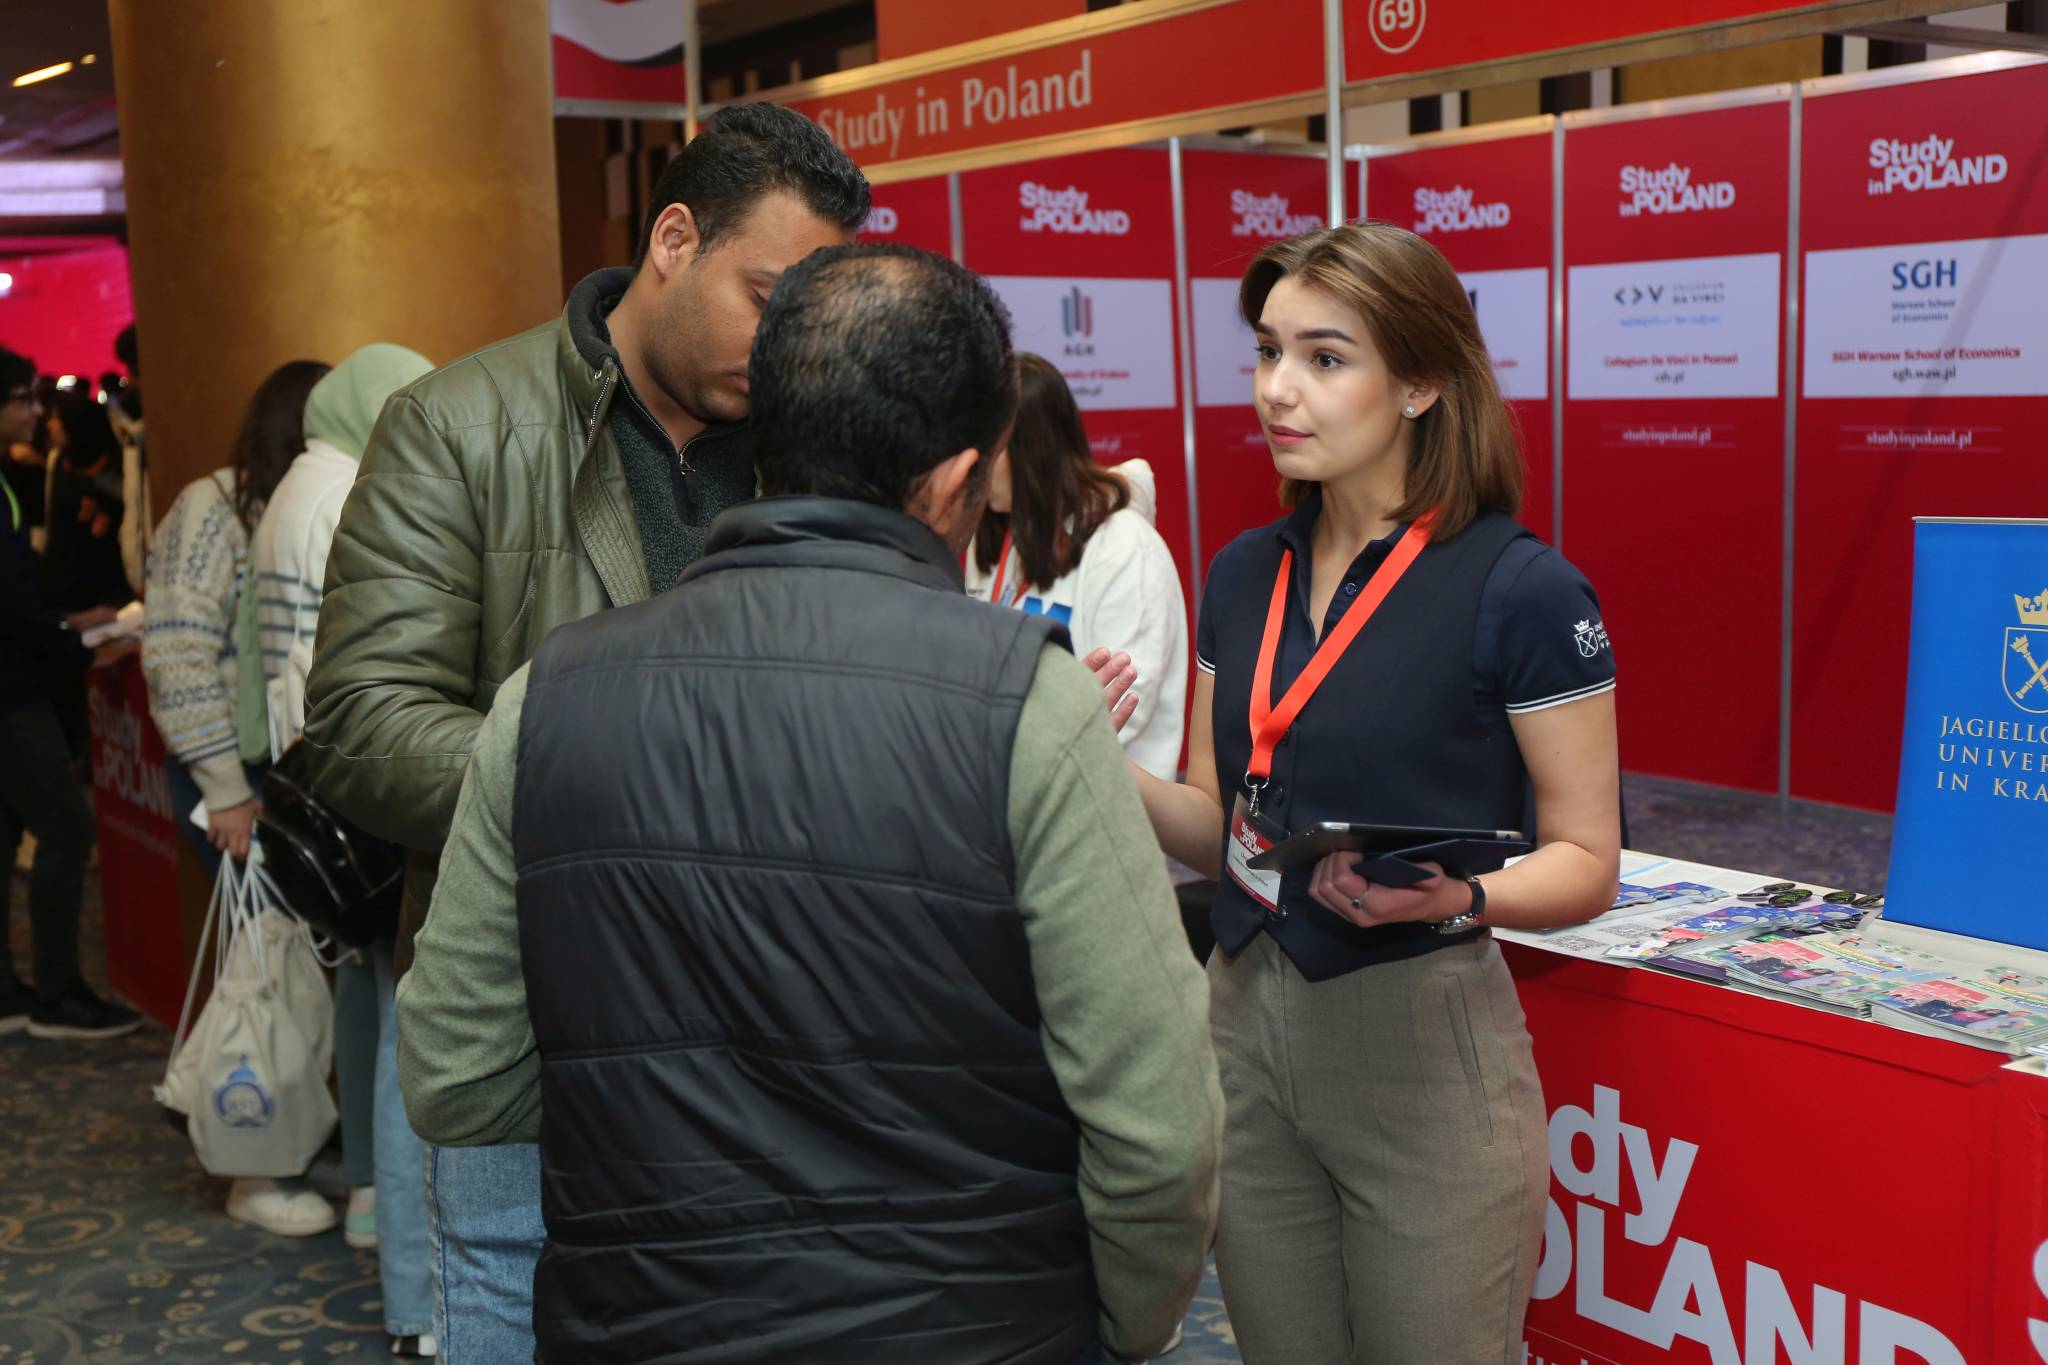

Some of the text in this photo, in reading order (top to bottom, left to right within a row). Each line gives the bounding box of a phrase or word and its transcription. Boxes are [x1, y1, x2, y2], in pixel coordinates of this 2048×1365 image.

[1379, 0, 1416, 32] 69
[916, 86, 949, 136] in
[962, 48, 1093, 128] Poland
[1868, 134, 1953, 167] Study
[1620, 162, 1690, 193] Study
[1020, 180, 1088, 213] Study
[1232, 189, 1288, 217] Study
[1414, 185, 1474, 213] Study
[1892, 259, 1957, 290] SGH
[1832, 345, 2021, 363] SGH Warsaw School of Economics
[1893, 366, 1956, 382] sgh.waw.pl
[1867, 430, 1973, 447] studyinpoland.pl
[1936, 771, 1969, 792] IN
